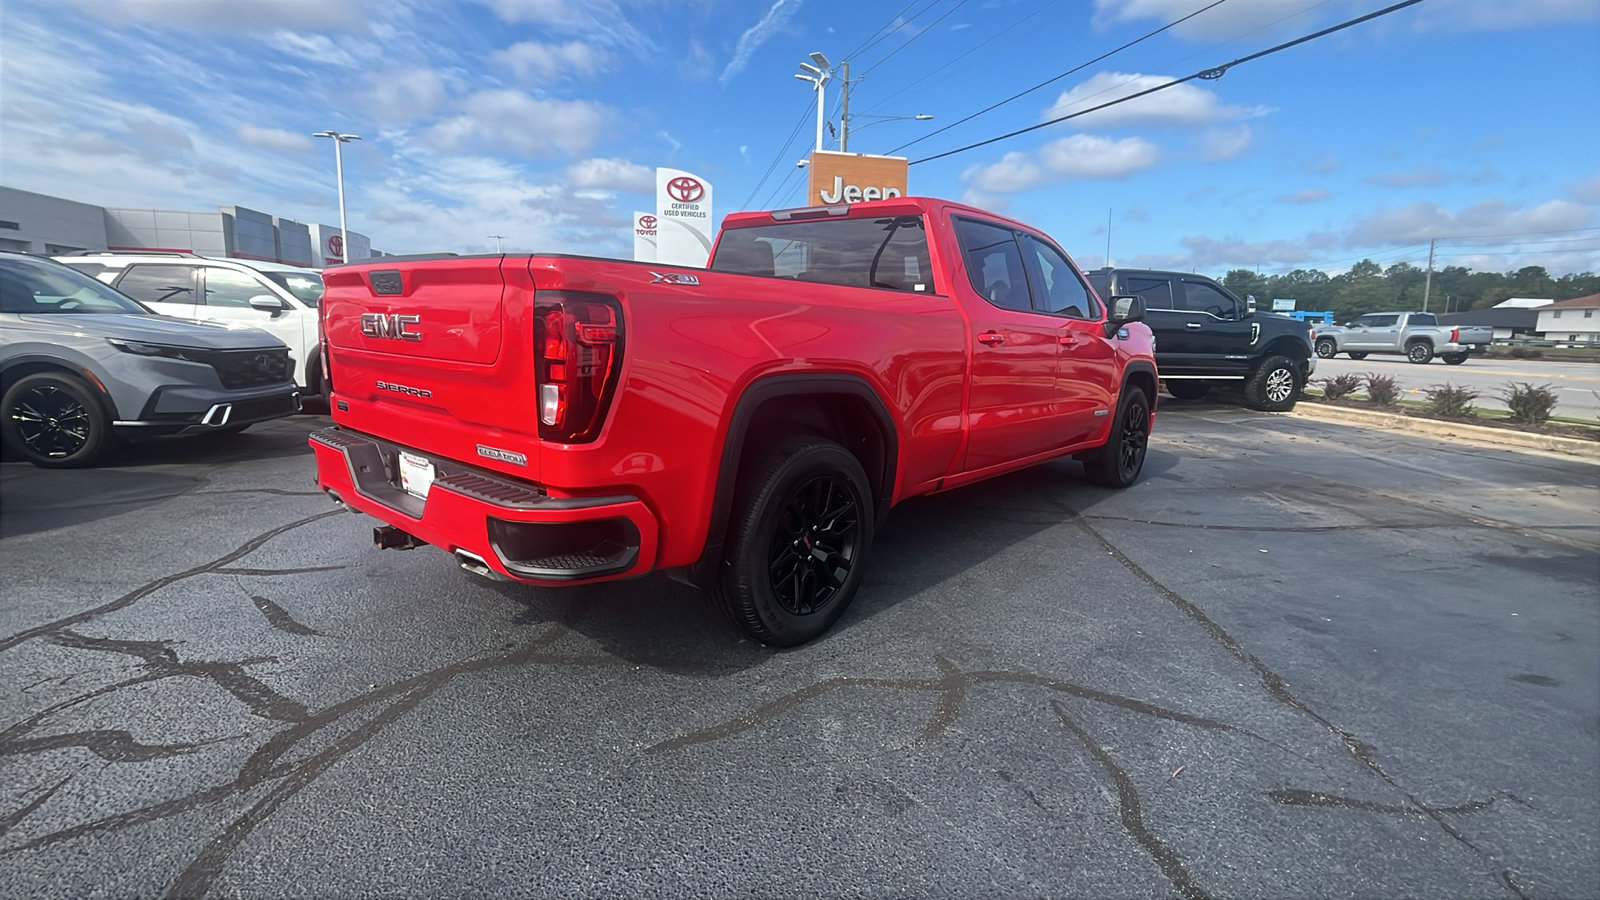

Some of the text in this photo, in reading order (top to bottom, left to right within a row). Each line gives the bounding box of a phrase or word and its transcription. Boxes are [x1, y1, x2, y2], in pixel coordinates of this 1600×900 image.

[671, 202, 699, 210] CERTIFIED
[361, 313, 422, 342] GMC
[376, 380, 432, 399] SIERRA
